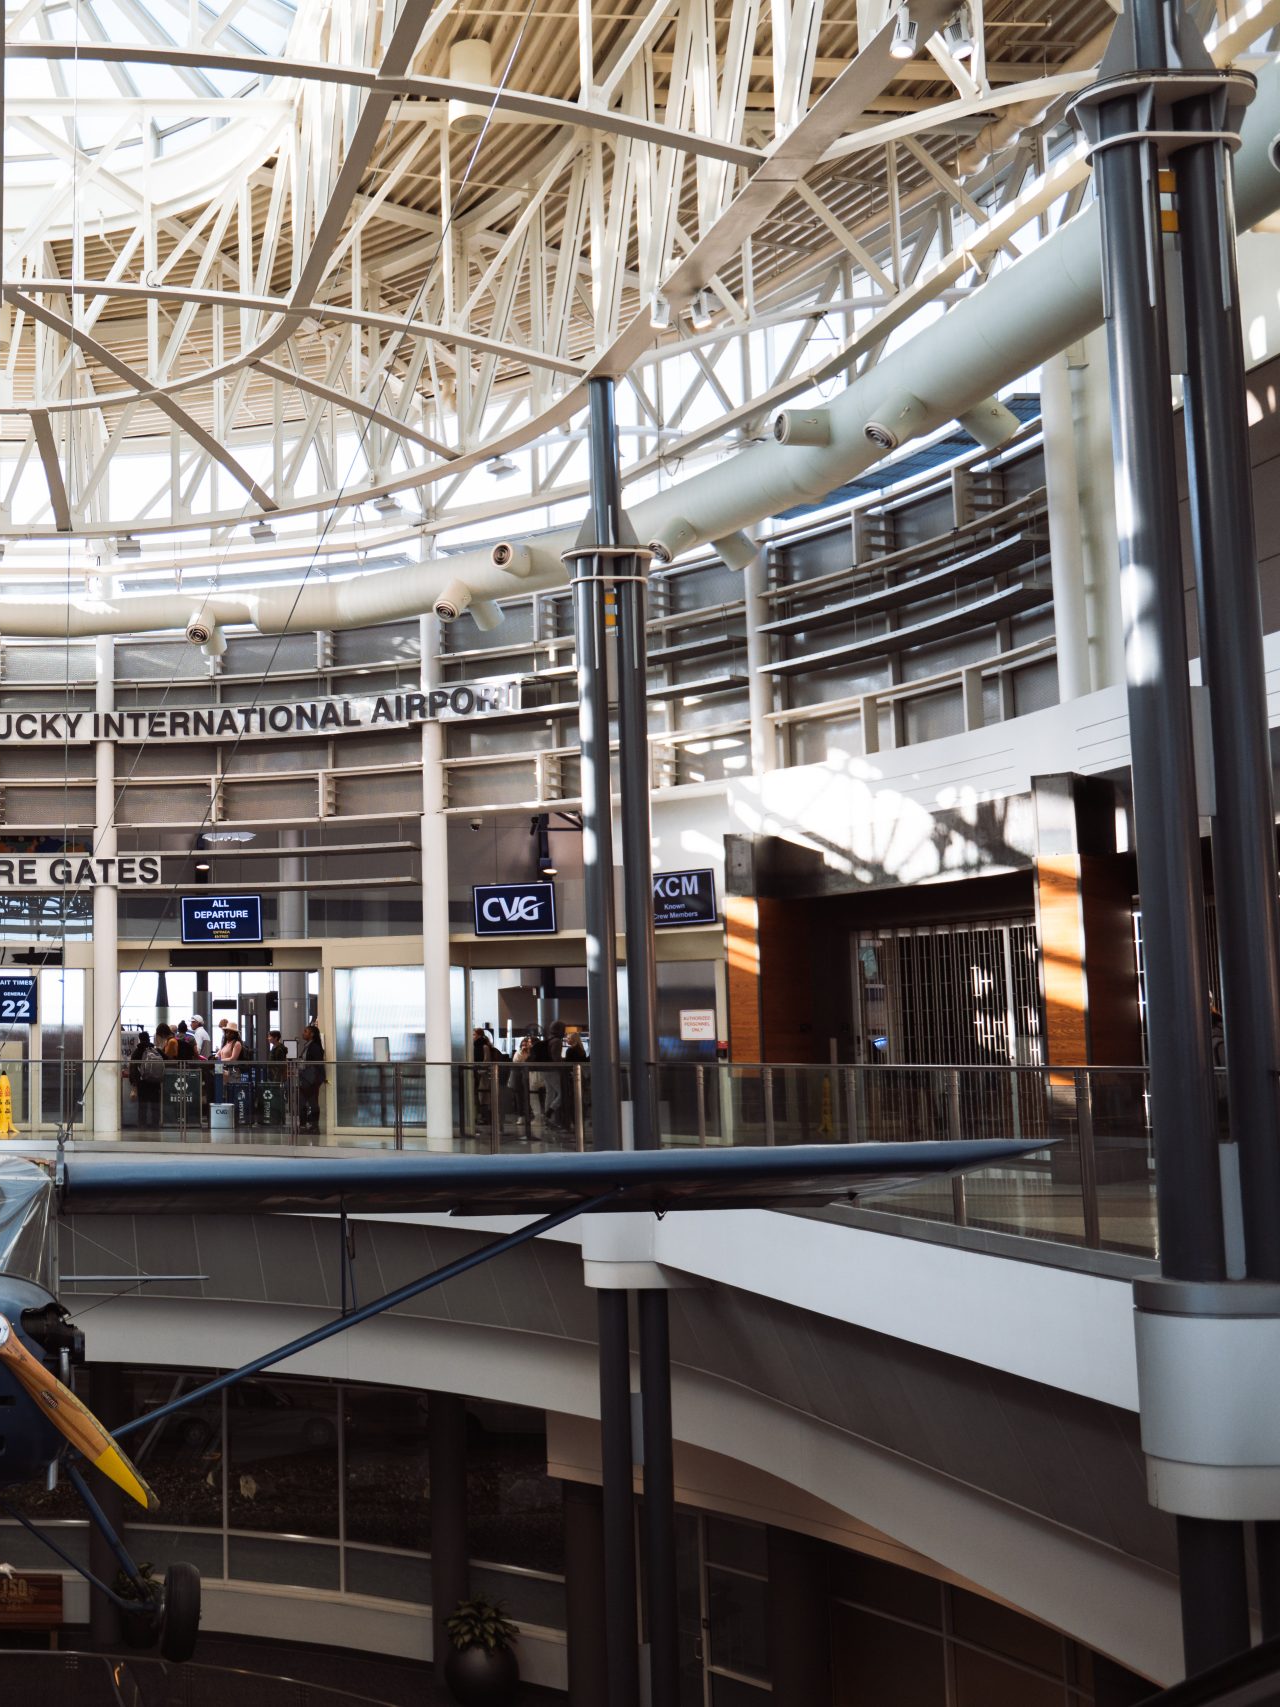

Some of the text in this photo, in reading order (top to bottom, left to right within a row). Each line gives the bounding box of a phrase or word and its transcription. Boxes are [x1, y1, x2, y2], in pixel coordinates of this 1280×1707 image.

[94, 701, 361, 738] INTERNATIONAL
[371, 682, 517, 724] AIRPORT
[49, 857, 159, 885] GATES
[653, 875, 699, 898] KCM
[212, 900, 230, 908] ALL
[482, 895, 545, 923] CVG
[664, 903, 686, 911] Known
[194, 910, 249, 919] DEPARTURE
[669, 911, 699, 919] Members
[206, 921, 237, 930] GATES
[1, 1000, 30, 1018] 22
